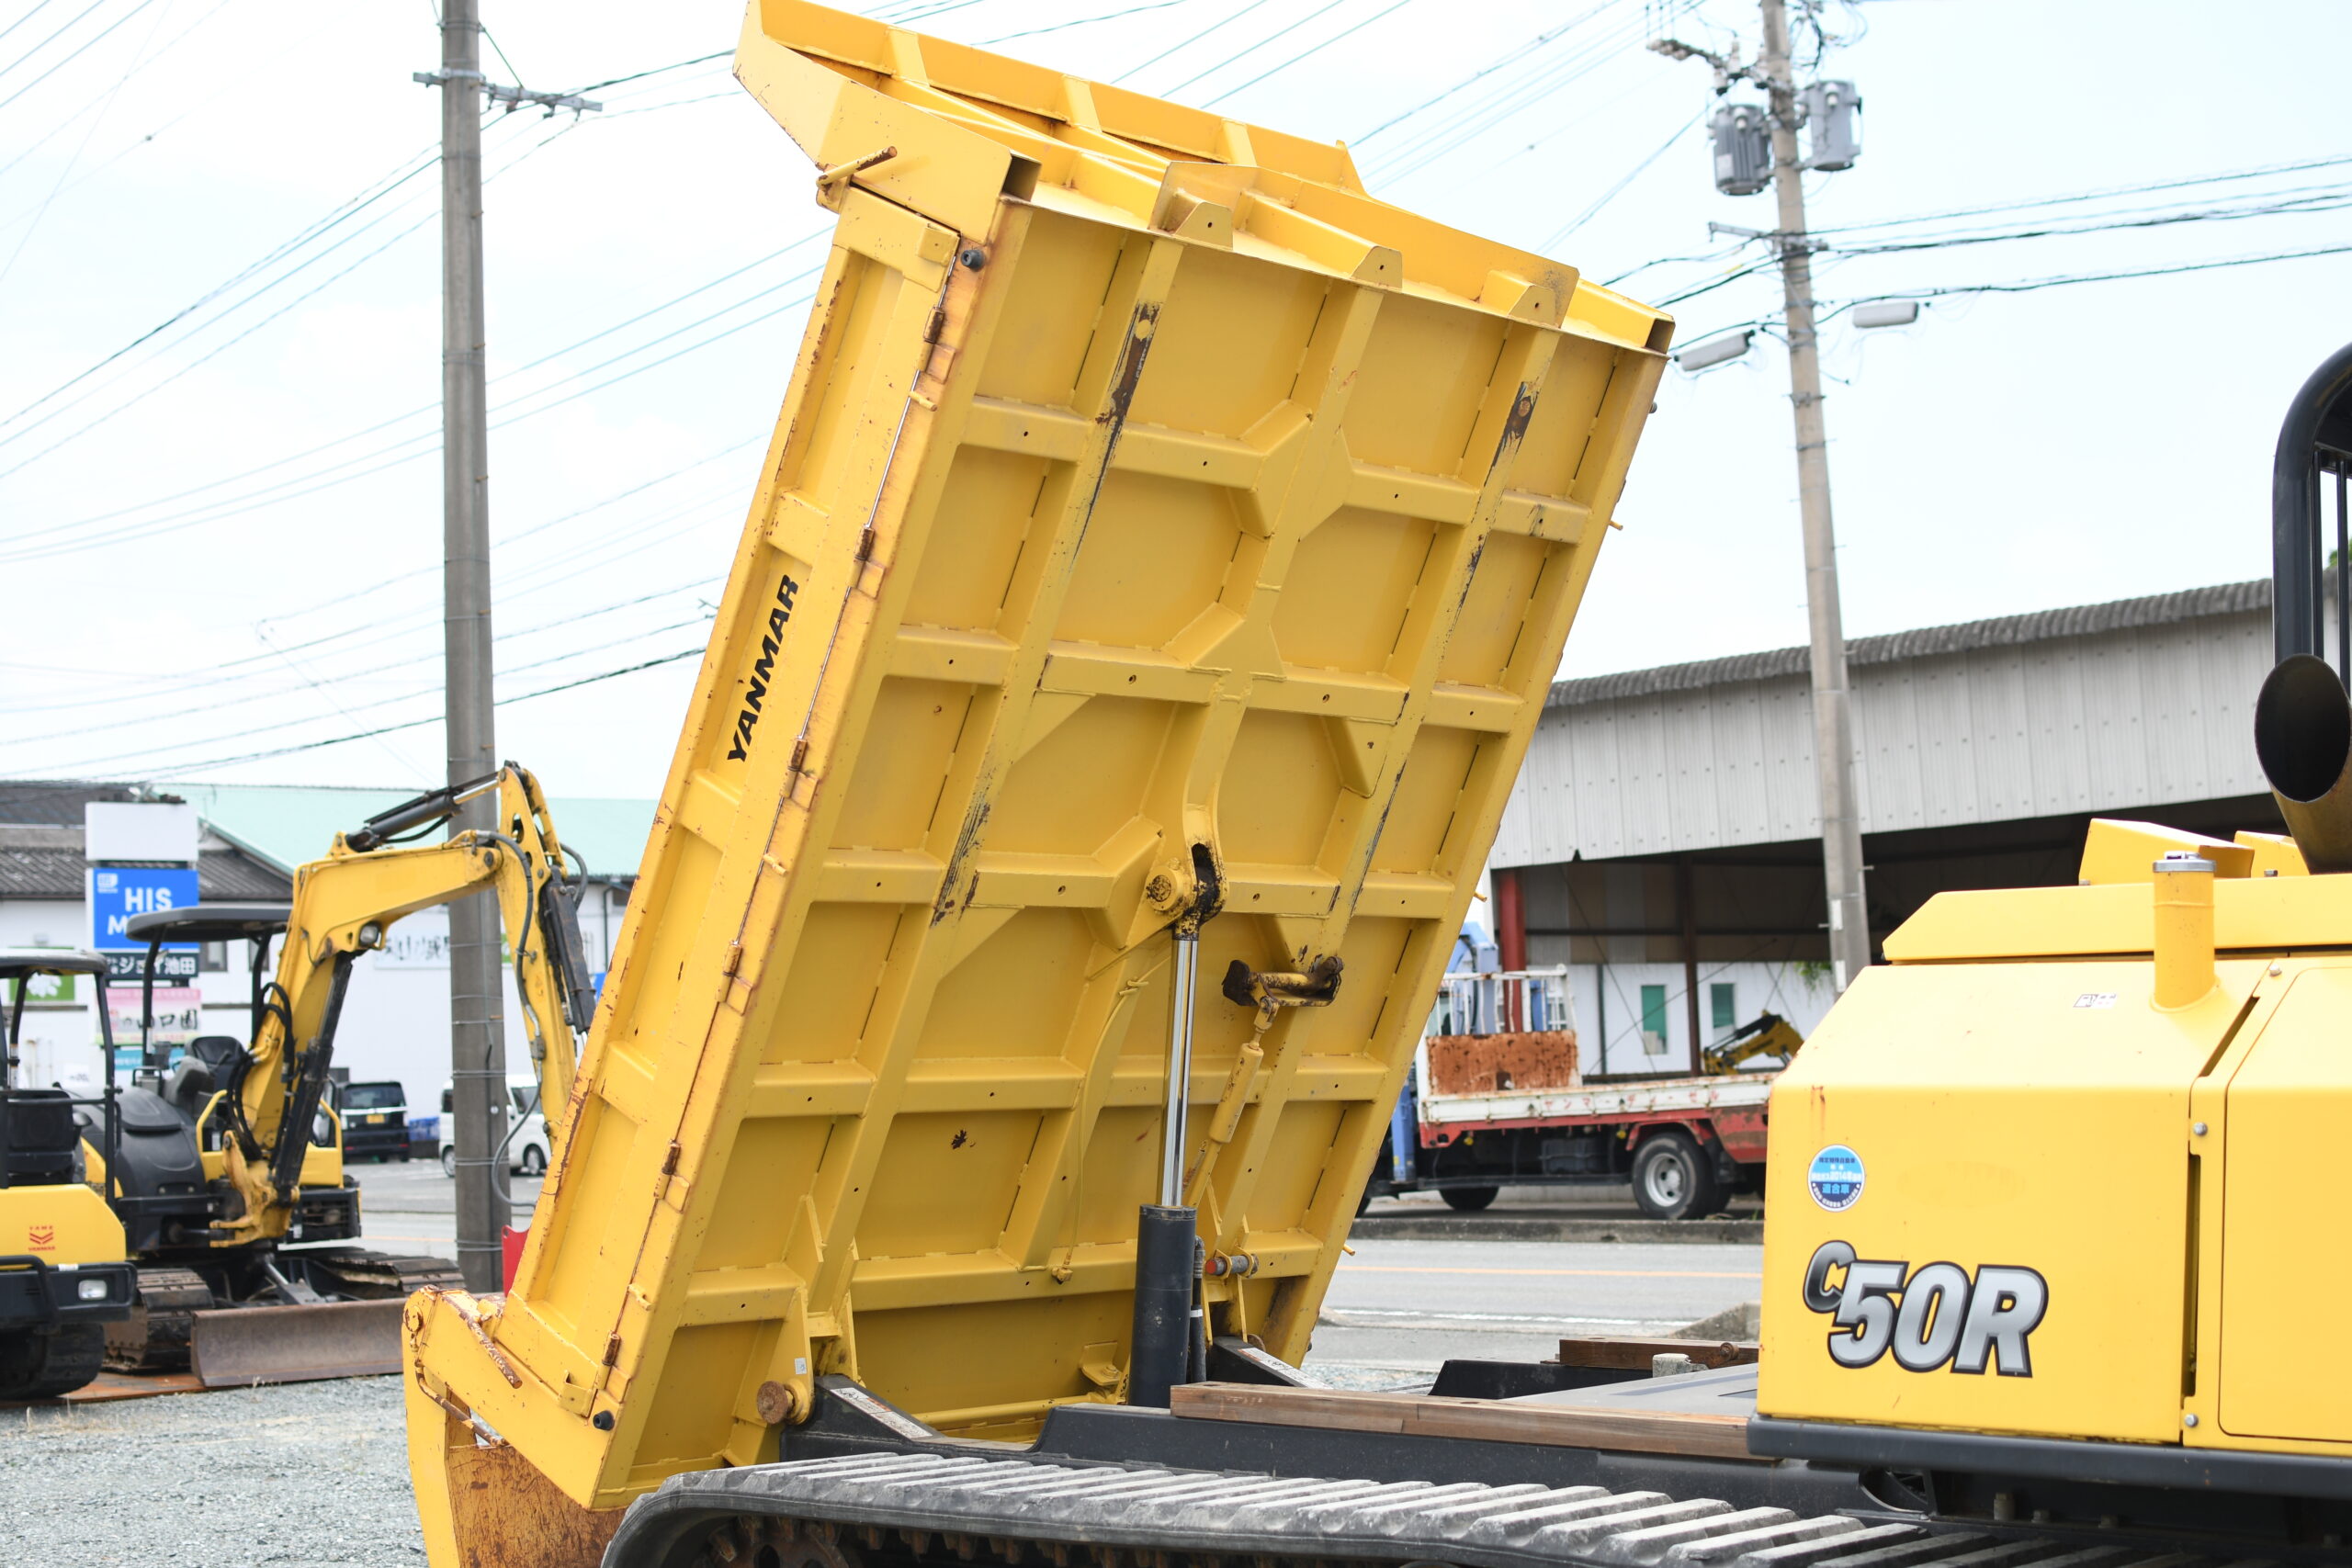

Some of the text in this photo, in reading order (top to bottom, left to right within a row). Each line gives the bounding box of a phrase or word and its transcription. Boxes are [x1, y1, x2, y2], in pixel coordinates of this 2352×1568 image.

[727, 574, 798, 761] YANMAR
[125, 886, 173, 912] HIS
[1803, 1240, 2049, 1378] C50R
